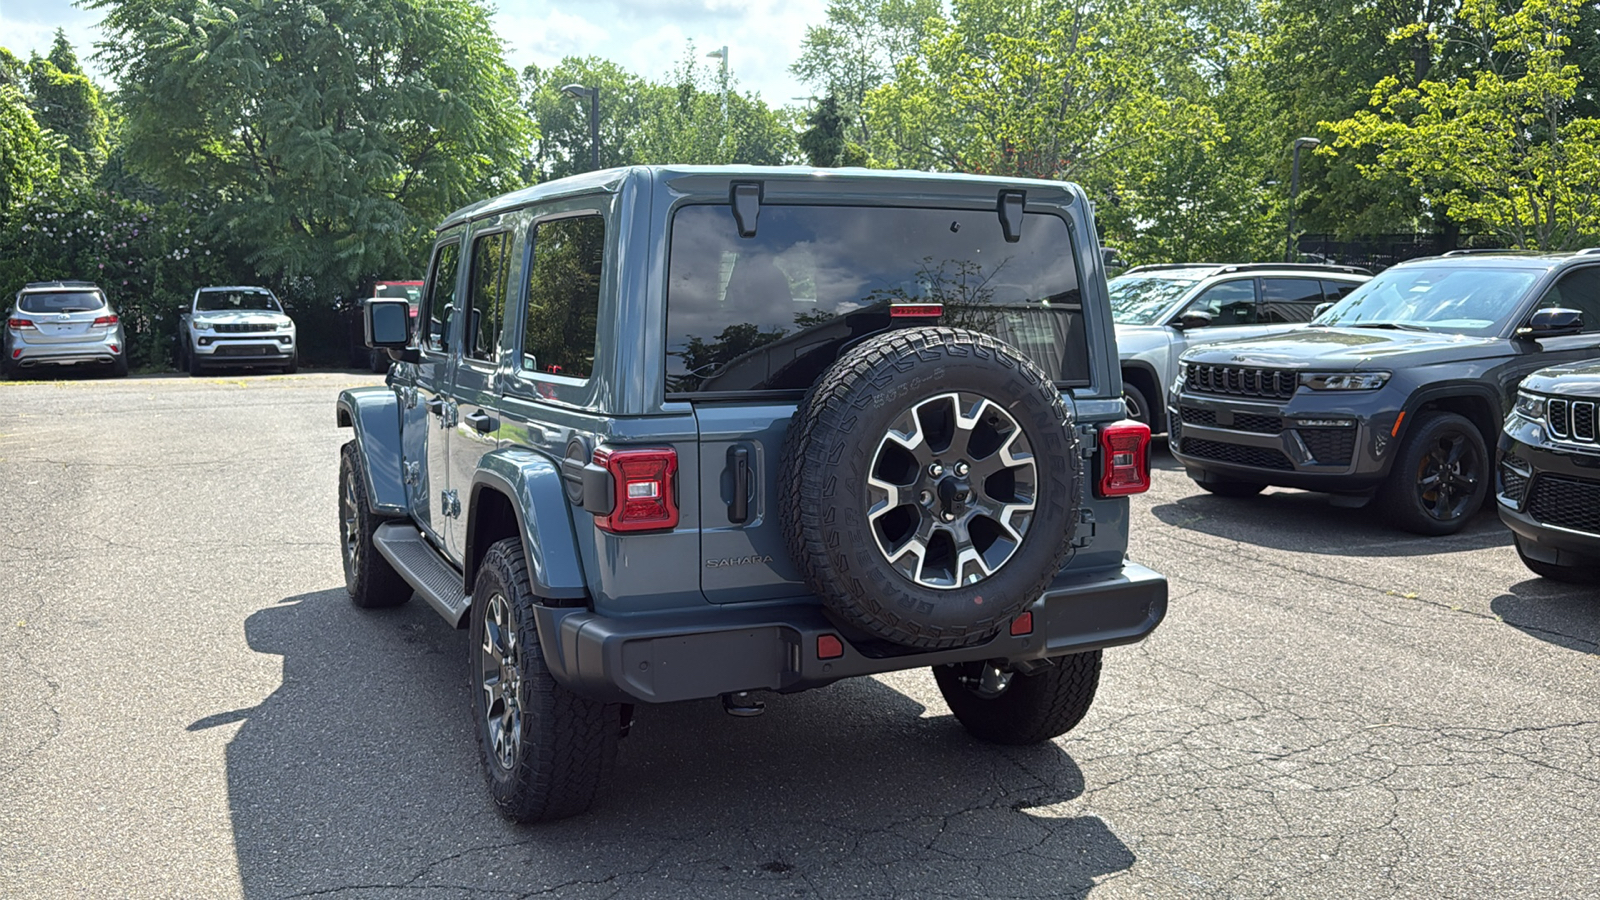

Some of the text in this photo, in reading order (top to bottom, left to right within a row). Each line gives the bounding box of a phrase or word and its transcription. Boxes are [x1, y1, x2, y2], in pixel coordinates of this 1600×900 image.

[1003, 379, 1067, 521] GENERAL
[705, 555, 774, 568] SAHARA
[844, 507, 935, 614] GRABBER
